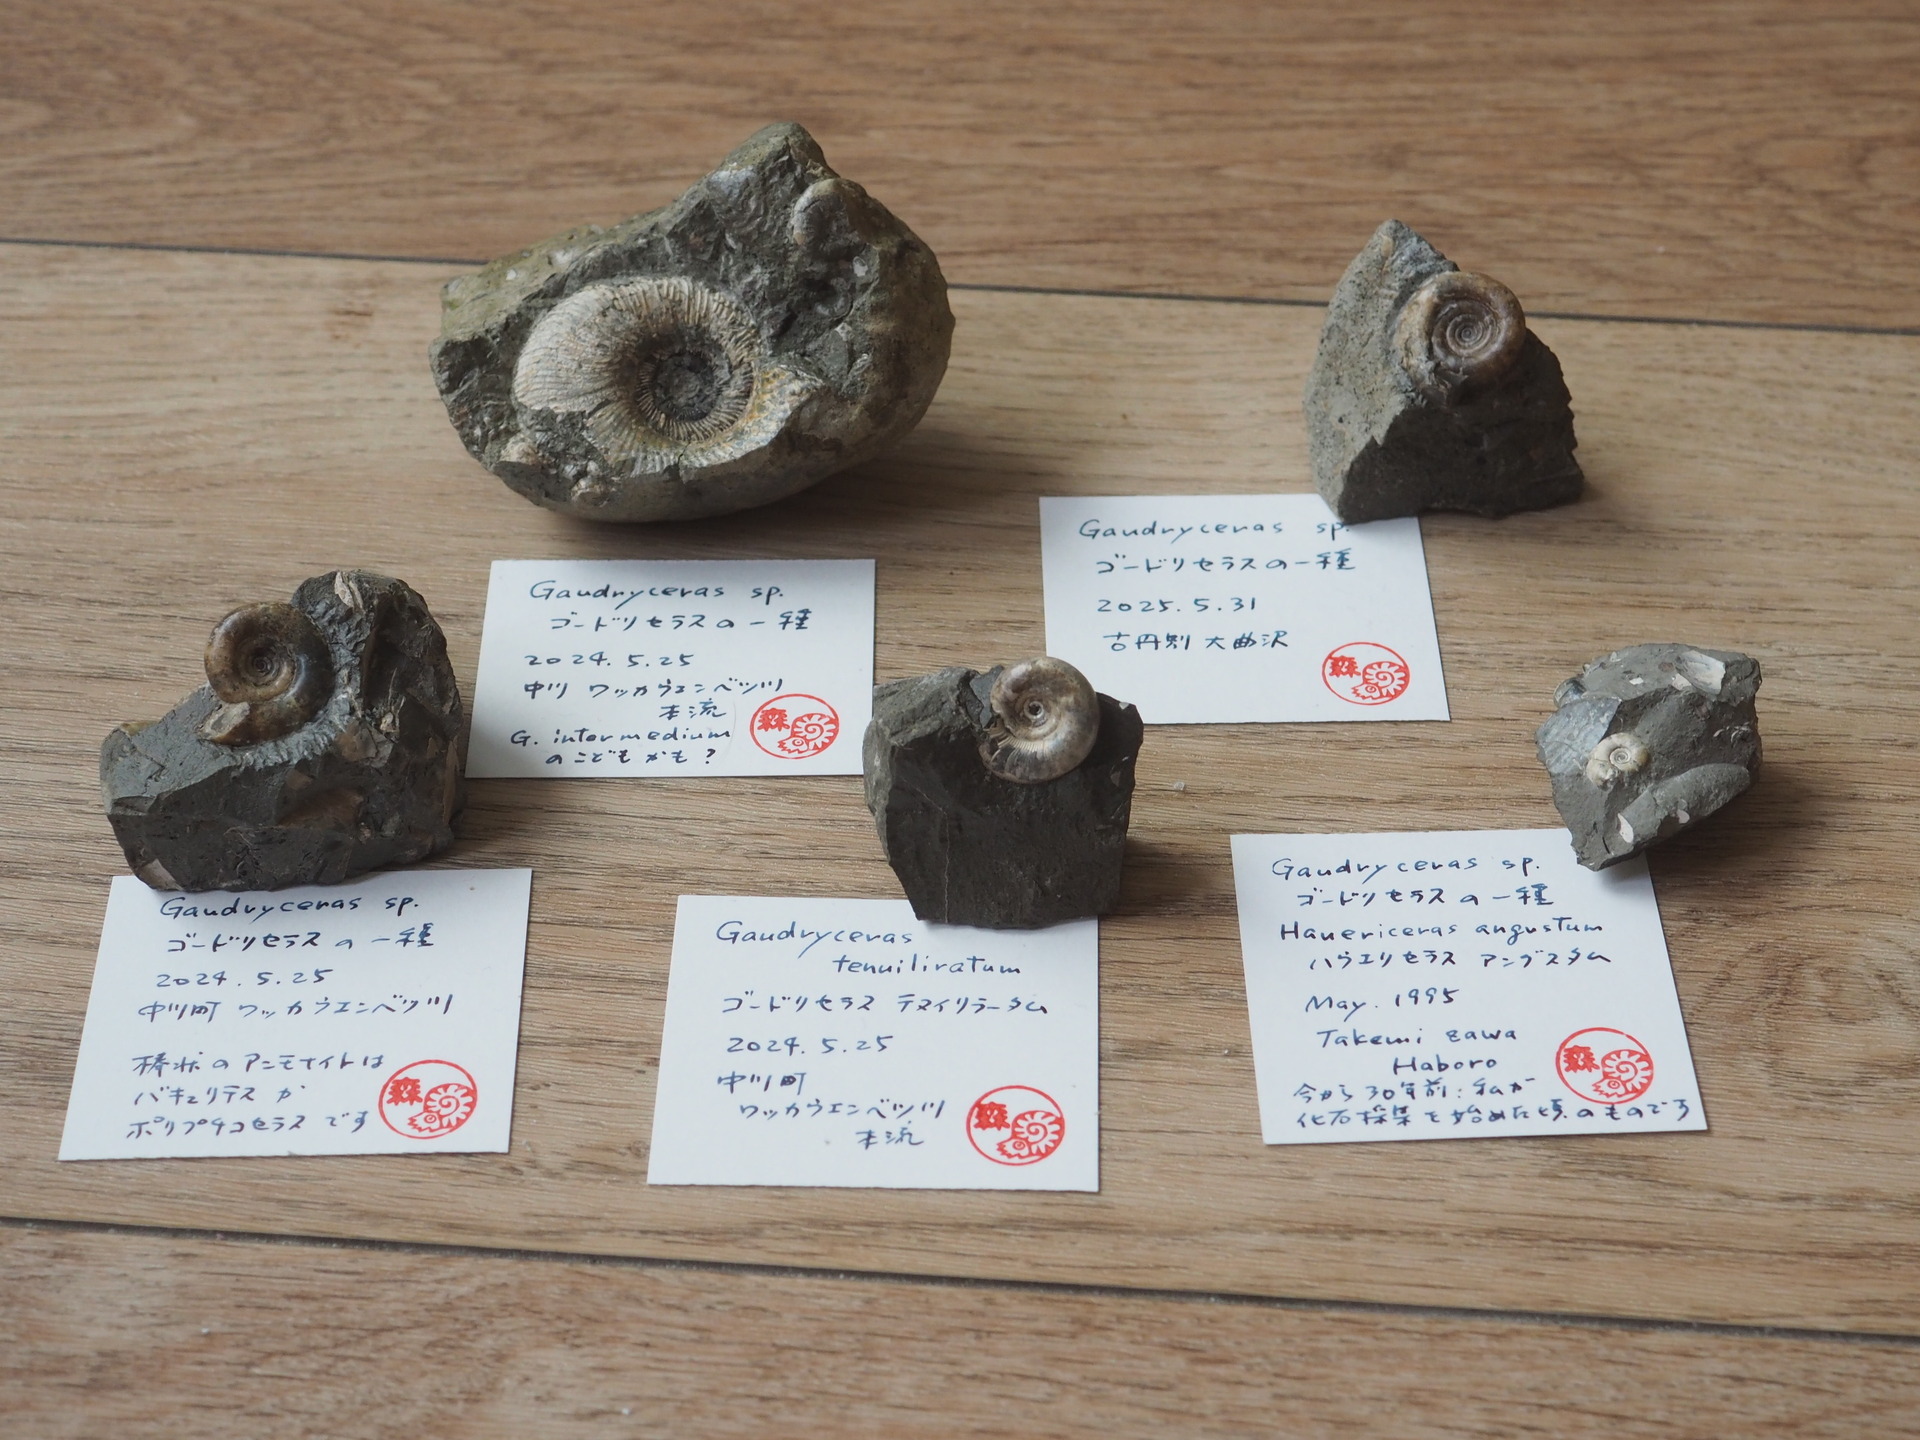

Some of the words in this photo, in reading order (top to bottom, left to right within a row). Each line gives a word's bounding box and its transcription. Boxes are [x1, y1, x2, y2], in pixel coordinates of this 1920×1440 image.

[1079, 519, 1282, 543] Gaudryceras
[530, 580, 725, 609] Gaudryceras
[751, 586, 783, 605] sp.
[511, 731, 538, 745] G.
[1502, 857, 1539, 877] sp.
[160, 896, 361, 922] Gaudryceras
[385, 896, 419, 916] sp.
[716, 921, 913, 958] Gaudryceras
[1475, 917, 1602, 945] angustum
[832, 953, 1020, 974] tenuiliratum
[1395, 987, 1459, 1007] 1995
[1393, 1054, 1497, 1075] Haboro
